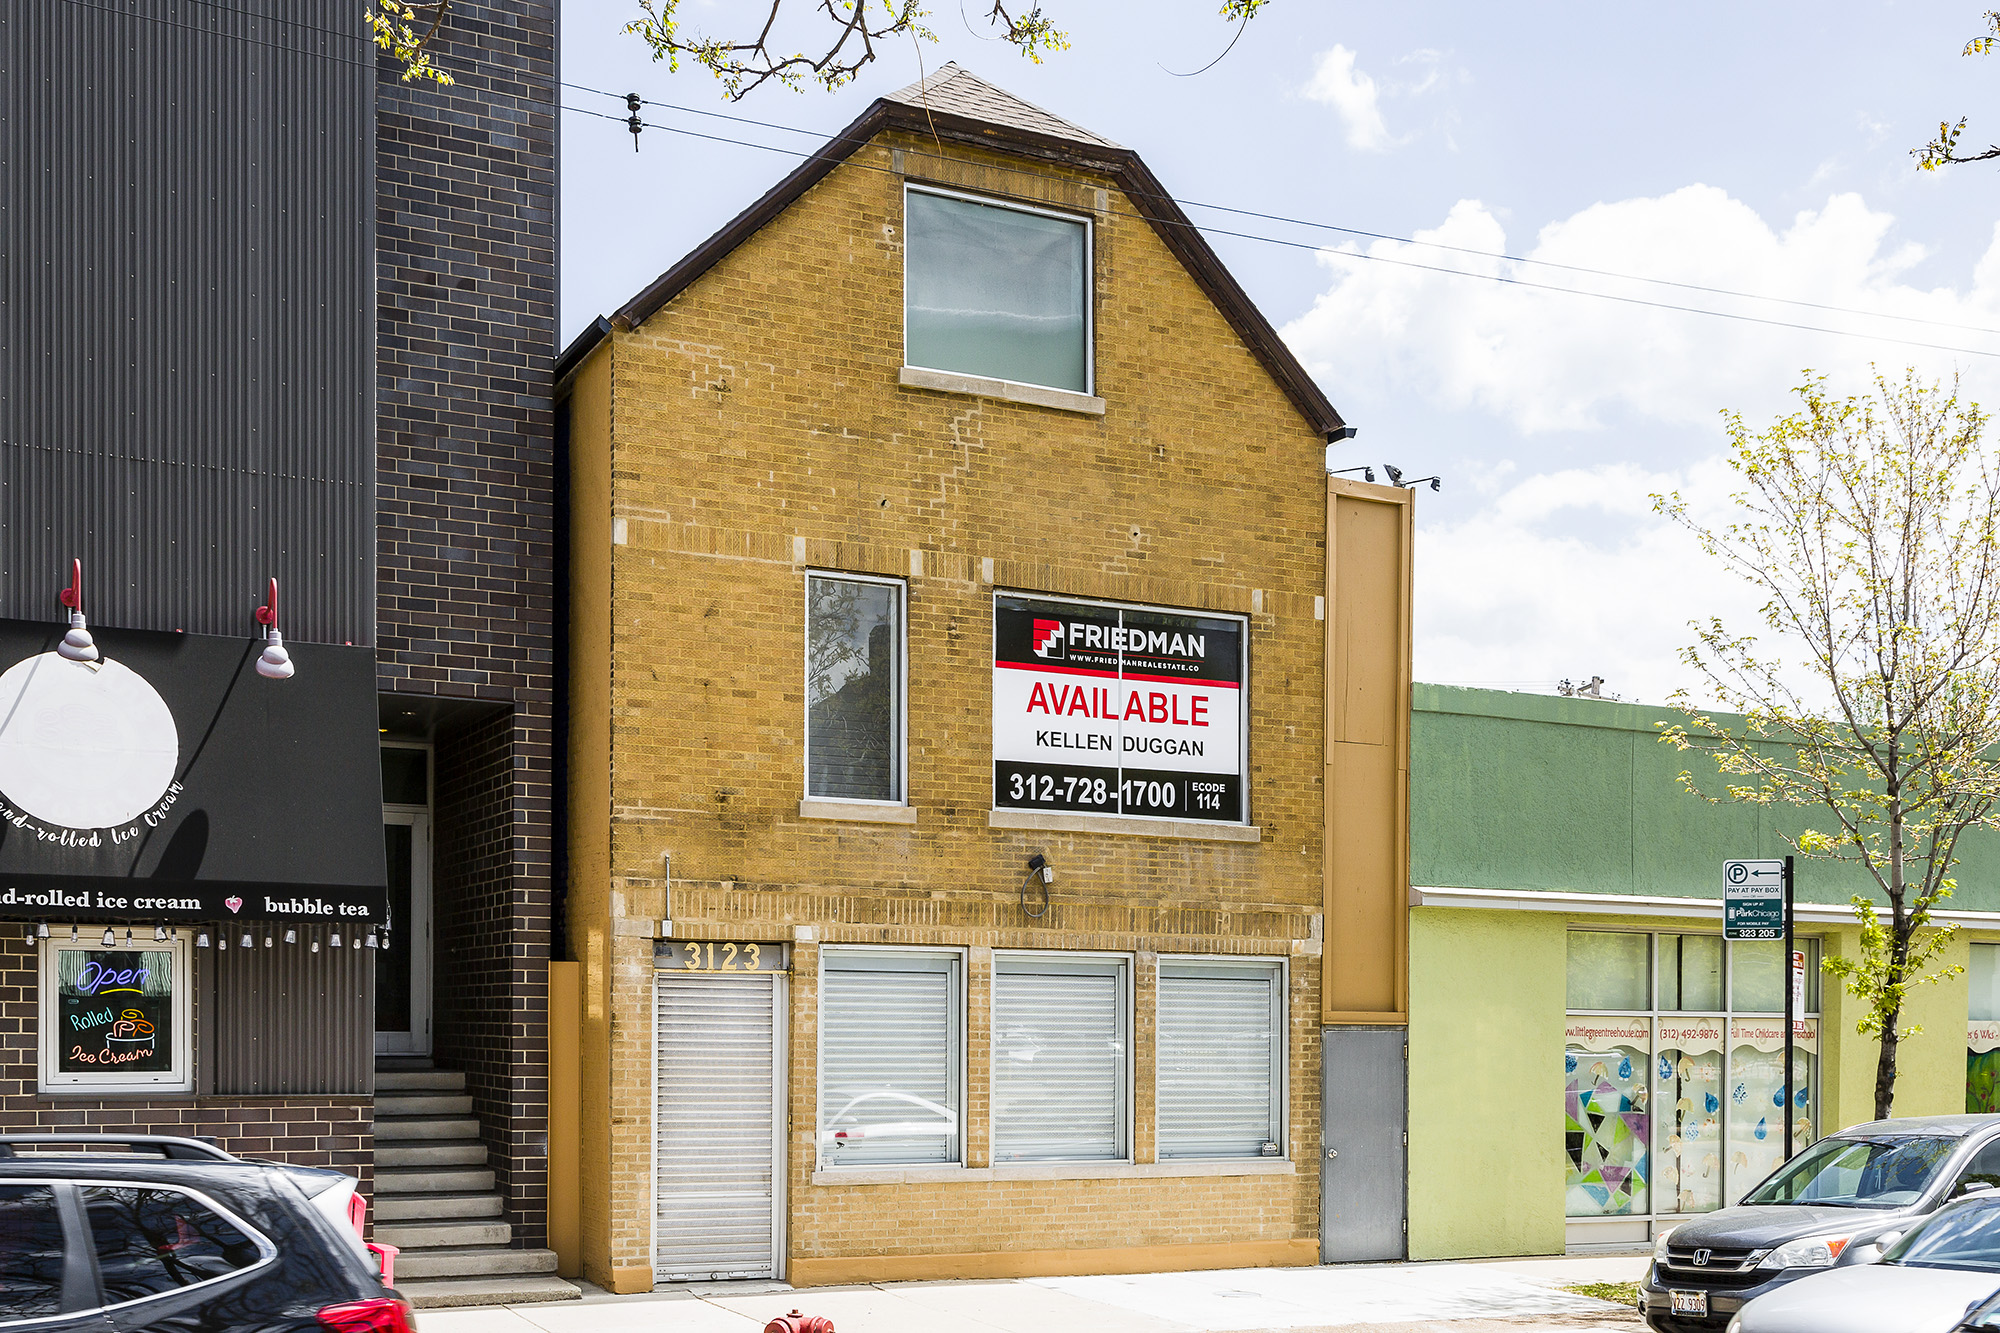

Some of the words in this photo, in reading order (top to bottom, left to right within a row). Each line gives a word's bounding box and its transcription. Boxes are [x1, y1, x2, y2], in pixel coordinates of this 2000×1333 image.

[1070, 622, 1204, 658] FRIEDMAN
[1070, 654, 1200, 672] WWW.FRIEDMANREALESTATE.CO
[1026, 682, 1209, 726] AVAILABLE
[1036, 730, 1112, 751] KELLEN
[1123, 736, 1204, 756] DUGGAN
[1010, 773, 1176, 808] 312-728-1700
[1192, 782, 1226, 793] ECODE
[144, 780, 184, 828] Cream
[1196, 794, 1220, 810] 114
[1734, 868, 1744, 880] P
[96, 892, 128, 908] ice
[134, 897, 202, 910] cream
[264, 896, 334, 915] bubble
[338, 902, 370, 916] tea
[1736, 909, 1780, 918] ParkChicago
[1739, 930, 1756, 938] 323
[1758, 930, 1775, 938] 205
[684, 942, 760, 970] 3123
[76, 962, 150, 994] Open
[70, 1006, 114, 1031] Rolled
[1660, 1028, 1679, 1040] (312)
[1681, 1029, 1719, 1039] 492-9876
[1741, 1028, 1754, 1038] Time
[1755, 1028, 1779, 1038] Childcare
[1974, 1030, 1978, 1039] 6
[1980, 1030, 1994, 1039] Wks
[69, 1045, 96, 1063] Ice
[99, 1048, 153, 1064] Cream
[1688, 1298, 1705, 1311] 9309
